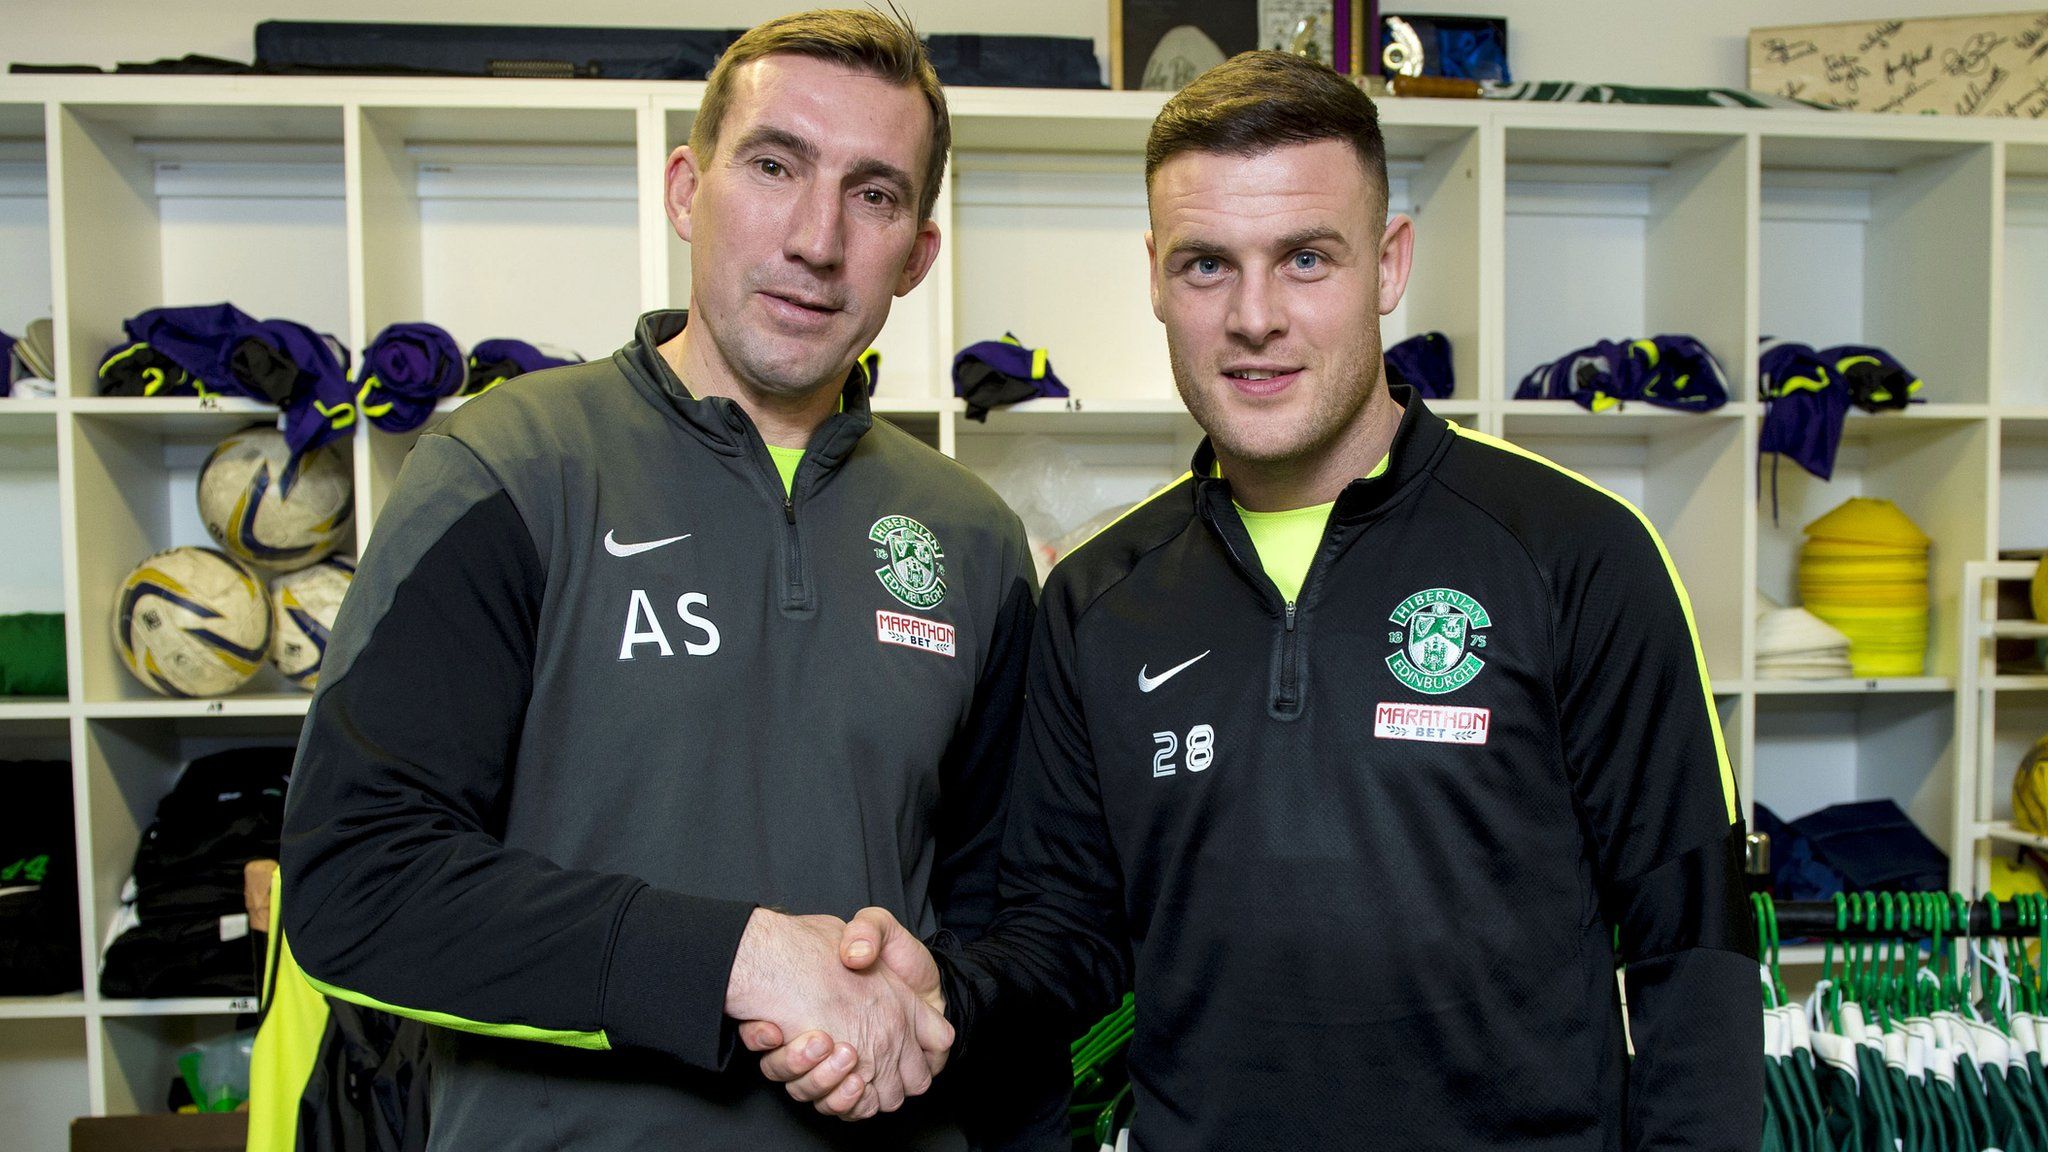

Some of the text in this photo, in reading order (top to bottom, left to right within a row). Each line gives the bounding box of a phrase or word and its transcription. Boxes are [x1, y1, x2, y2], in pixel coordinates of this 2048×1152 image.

[874, 518, 940, 550] HIBERNIAN
[883, 573, 945, 605] EDINBURGH
[1396, 591, 1484, 622] HIBERNIAN
[879, 614, 955, 645] MARATHON
[910, 636, 931, 648] BET
[1388, 631, 1487, 648] 18 75
[1393, 660, 1475, 689] EDINBURGH
[1378, 707, 1487, 731] MARATHON
[1415, 727, 1447, 739] BET
[1152, 723, 1215, 778] 28
